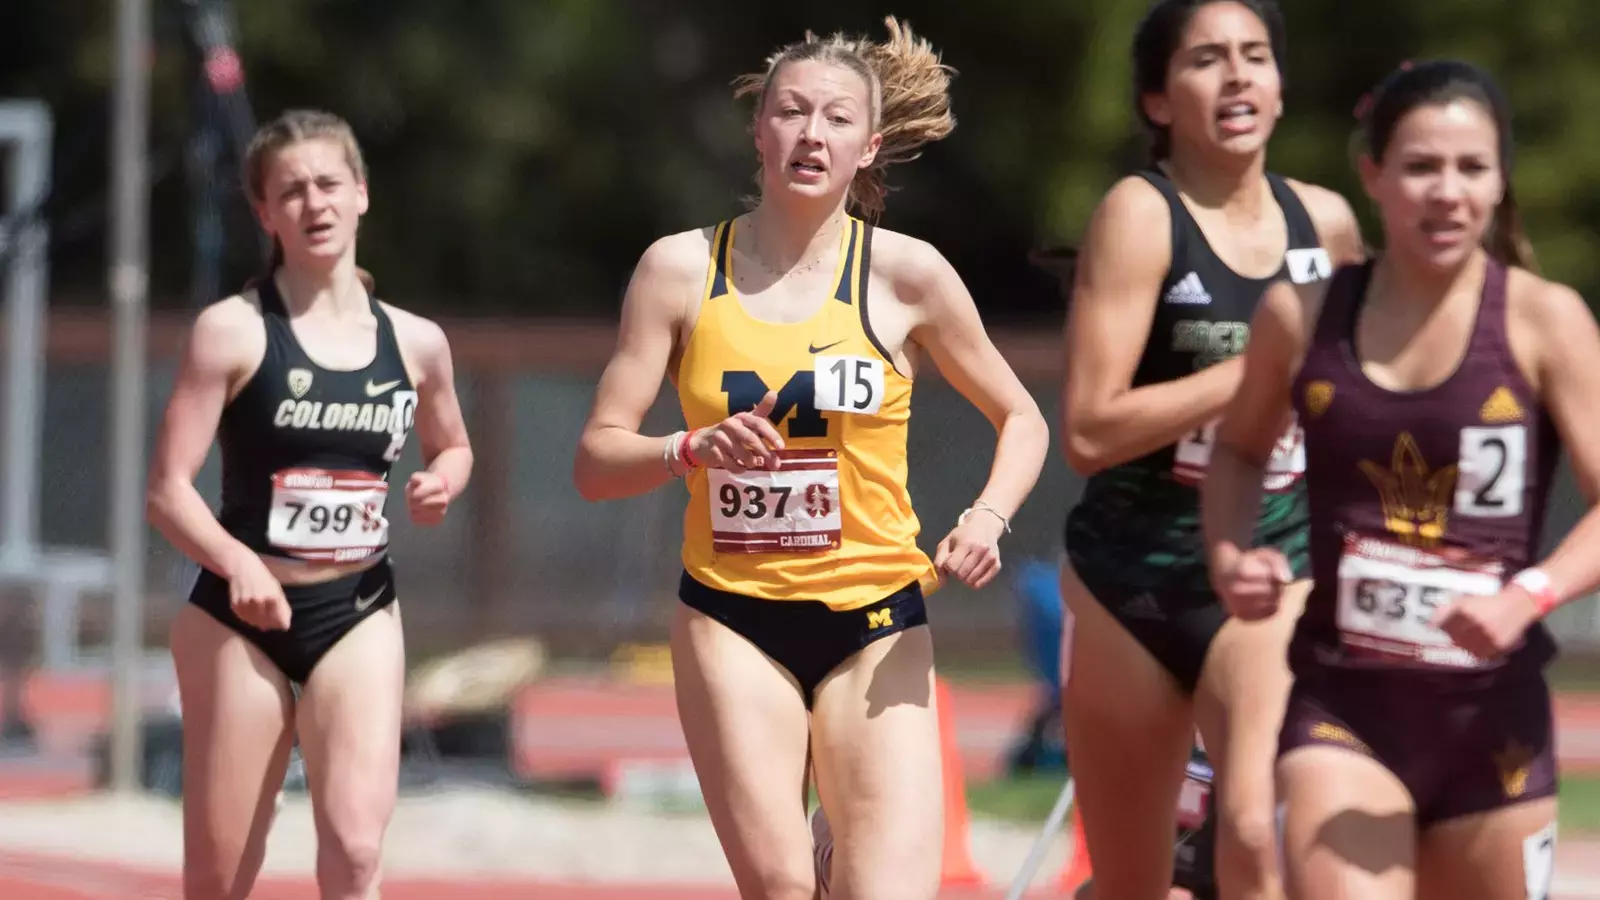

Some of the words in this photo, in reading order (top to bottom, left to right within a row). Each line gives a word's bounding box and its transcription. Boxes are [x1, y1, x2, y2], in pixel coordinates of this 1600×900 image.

[830, 359, 873, 410] 15
[720, 370, 828, 437] M
[1473, 438, 1507, 507] 2
[285, 501, 353, 533] 799
[719, 483, 792, 519] 937
[780, 534, 831, 547] CARDINAL
[868, 607, 893, 629] M
